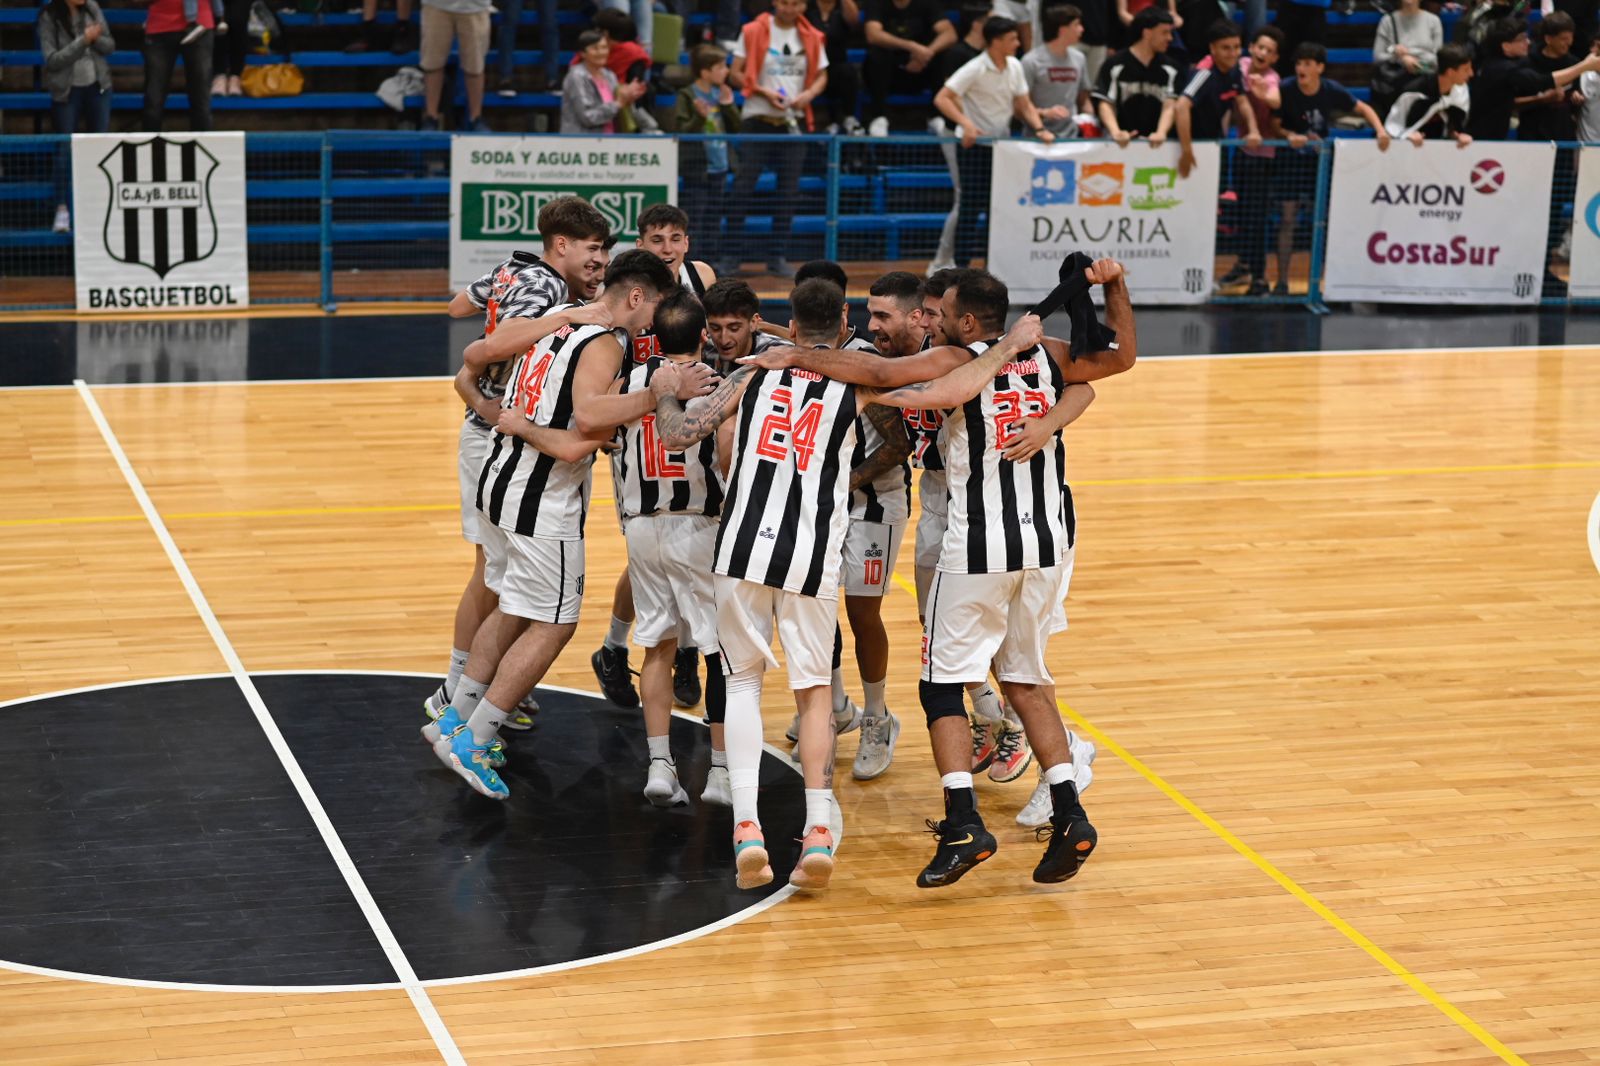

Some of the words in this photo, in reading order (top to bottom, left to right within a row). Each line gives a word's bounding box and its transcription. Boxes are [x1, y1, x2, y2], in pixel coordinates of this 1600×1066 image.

[471, 151, 516, 166] SODA
[520, 151, 532, 165] Y
[537, 151, 583, 167] AGUA
[588, 152, 609, 167] DE
[614, 152, 661, 168] MESA
[169, 186, 199, 201] BELL
[1371, 184, 1465, 206] AXION
[1419, 207, 1463, 222] energy
[1032, 215, 1172, 244] DAURIA
[1367, 231, 1501, 266] CostaSur
[88, 285, 238, 309] BASQUETBOL
[755, 387, 825, 473] 24
[915, 435, 931, 461] 7
[863, 559, 883, 585] 10
